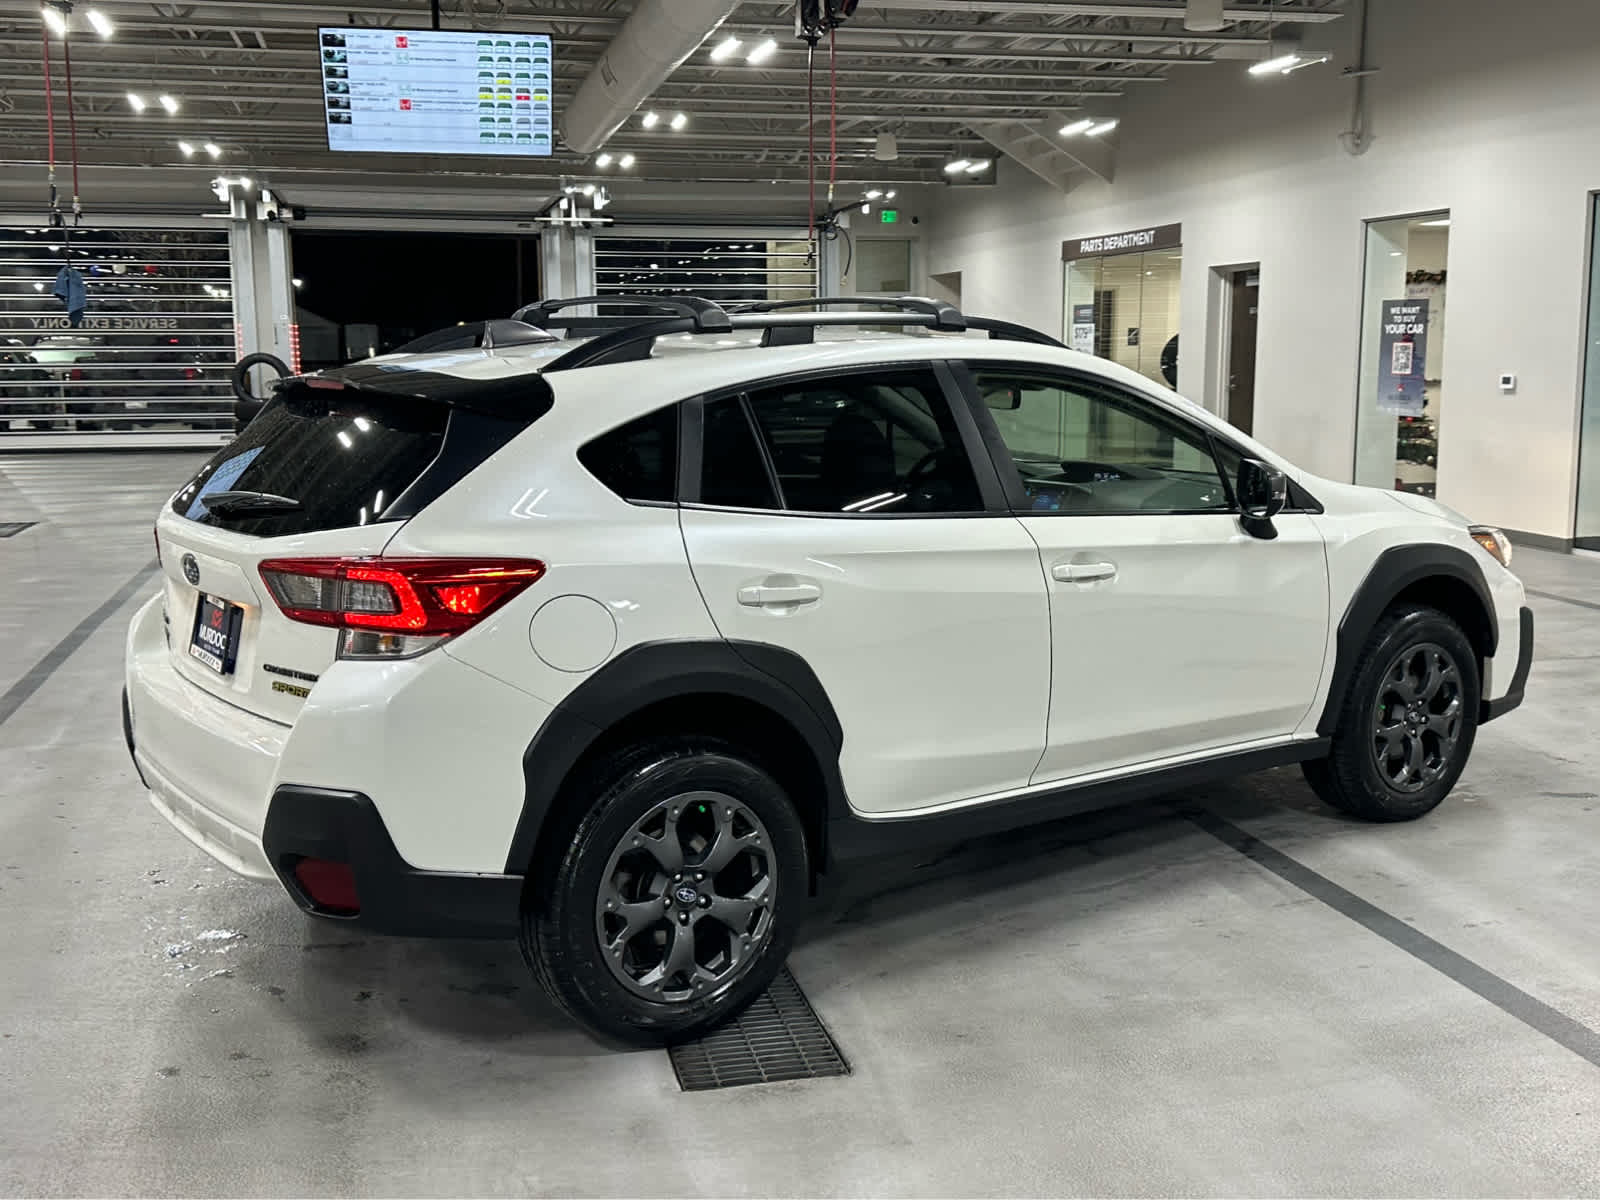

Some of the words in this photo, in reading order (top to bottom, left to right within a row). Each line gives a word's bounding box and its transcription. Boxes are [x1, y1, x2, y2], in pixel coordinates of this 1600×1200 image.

[1080, 239, 1103, 254] PARTS
[1103, 230, 1156, 251] DEPARTMENT
[1390, 306, 1401, 315] WE
[1384, 323, 1406, 334] YOUR
[1407, 323, 1425, 334] CAR
[199, 623, 227, 650] MURDOC
